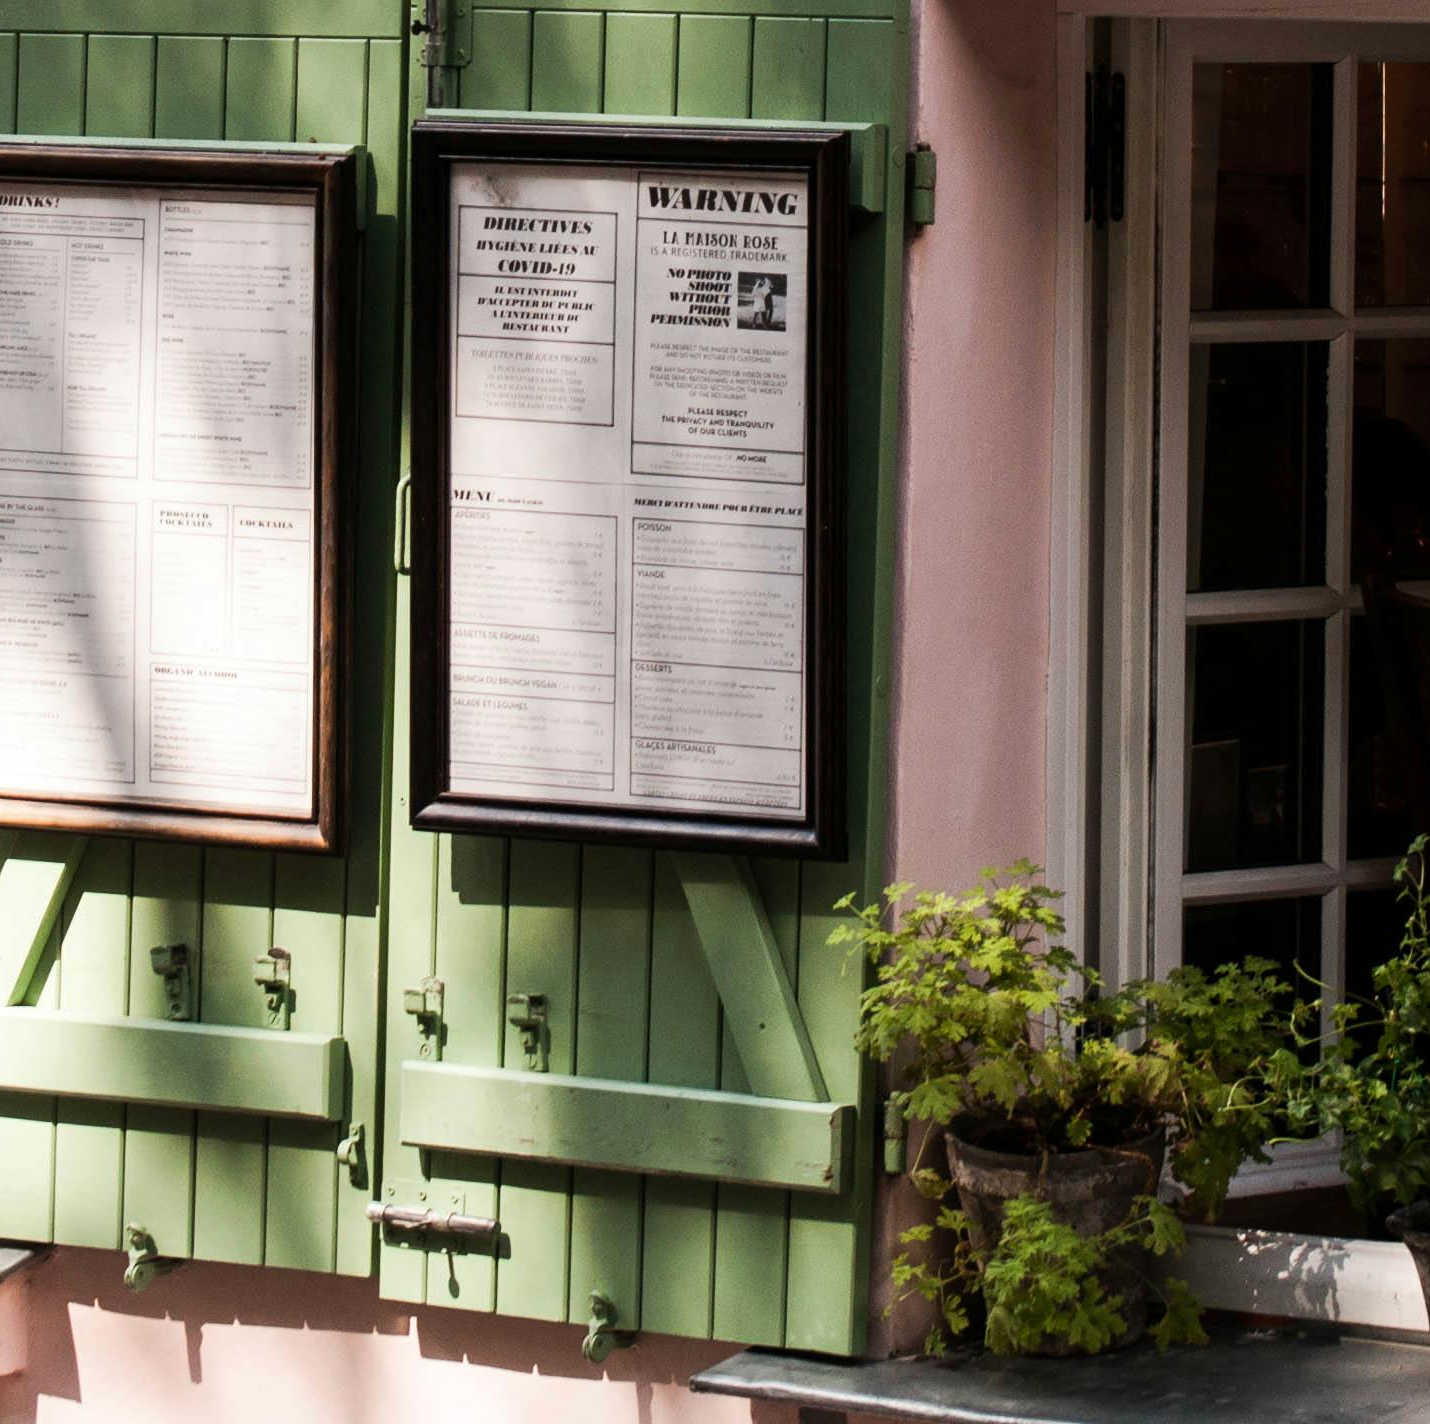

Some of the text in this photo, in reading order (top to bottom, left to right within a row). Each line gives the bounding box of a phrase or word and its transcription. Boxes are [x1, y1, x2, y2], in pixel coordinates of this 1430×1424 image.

[648, 186, 798, 215] WARNING
[484, 217, 593, 234] DIRECTIVES
[663, 231, 779, 250] LA MAISON ROSE
[581, 245, 598, 256] AU
[651, 247, 658, 255] IS
[662, 248, 668, 256] A
[671, 248, 726, 260] REGISTERED
[498, 259, 576, 275] COVID-19
[667, 268, 731, 281] NO PHOTO
[495, 286, 578, 298] IL EST INTERDIT
[687, 281, 732, 292] SHOOT
[670, 292, 731, 304] WITHOUT
[558, 302, 595, 312] PUBLIC
[689, 304, 730, 316] PRIOR
[651, 314, 731, 328] PERMISSION
[502, 323, 570, 333] RESTAURANT
[688, 407, 747, 418] PLEASE RESPECT
[662, 415, 774, 429] THE PRIVACY AND TRANQUILITY
[700, 428, 715, 436] OUR
[717, 429, 747, 438] CLIENTS
[452, 489, 494, 502] MENU
